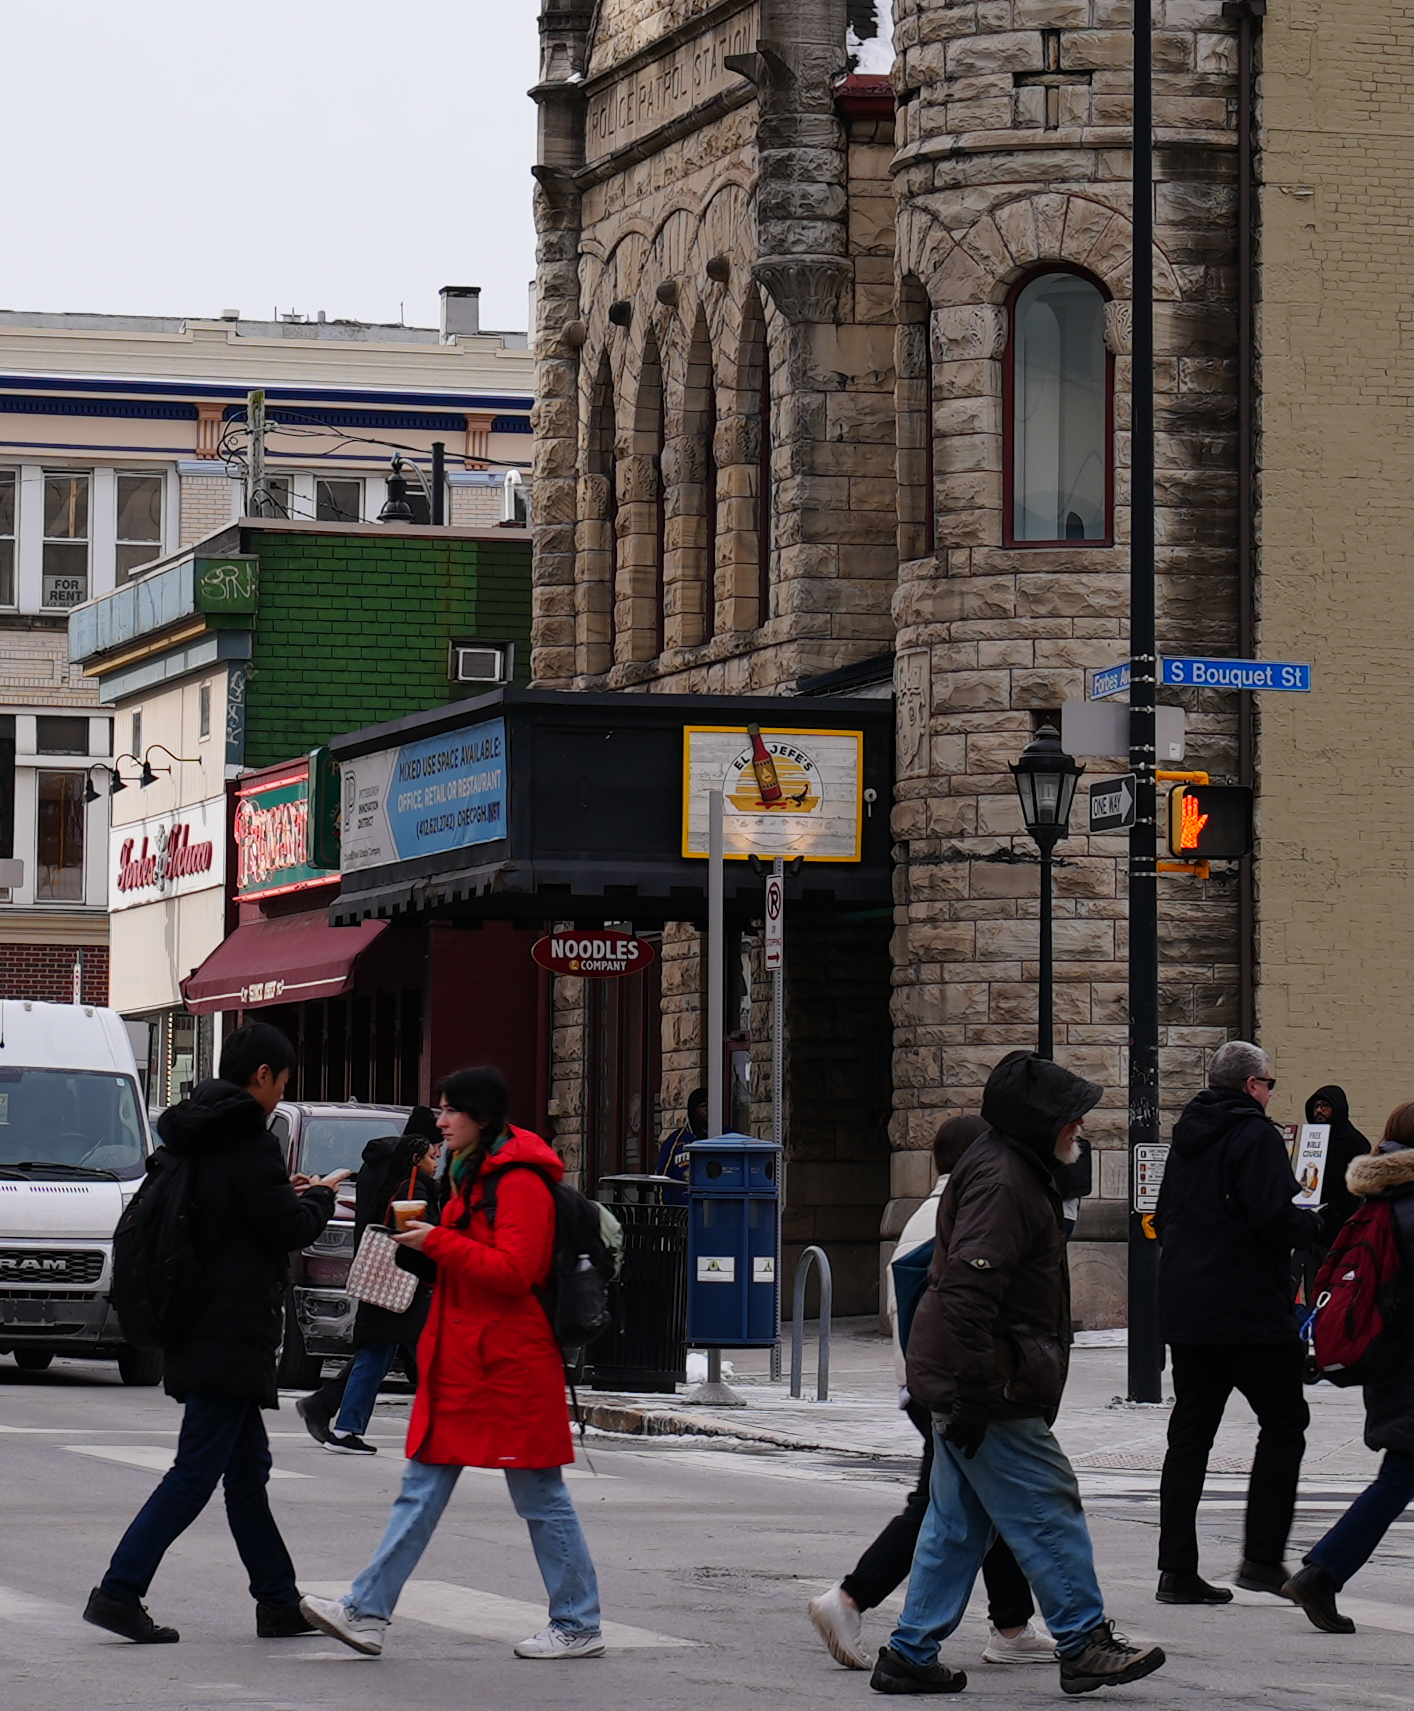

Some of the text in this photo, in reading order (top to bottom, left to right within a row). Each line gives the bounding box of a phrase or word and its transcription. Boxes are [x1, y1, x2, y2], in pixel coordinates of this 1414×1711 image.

[591, 22, 752, 146] POLICE PATROL STATION
[50, 590, 83, 601] RENT
[54, 579, 79, 590] FOR
[1094, 663, 1131, 696] Forbes Av
[1170, 661, 1303, 688] S Bouquet St
[399, 759, 422, 782] MIXED
[422, 753, 436, 777] USE
[437, 748, 459, 773] SPACE
[733, 744, 814, 772] EL JEFE'S
[424, 784, 447, 807] RETAIL
[447, 780, 457, 800] OR
[457, 768, 502, 798] RESTAURANT
[1093, 793, 1123, 817] ONE WAY
[165, 823, 213, 881] Tobacco
[551, 938, 640, 960] NOODLES
[580, 960, 628, 972] COMPANY
